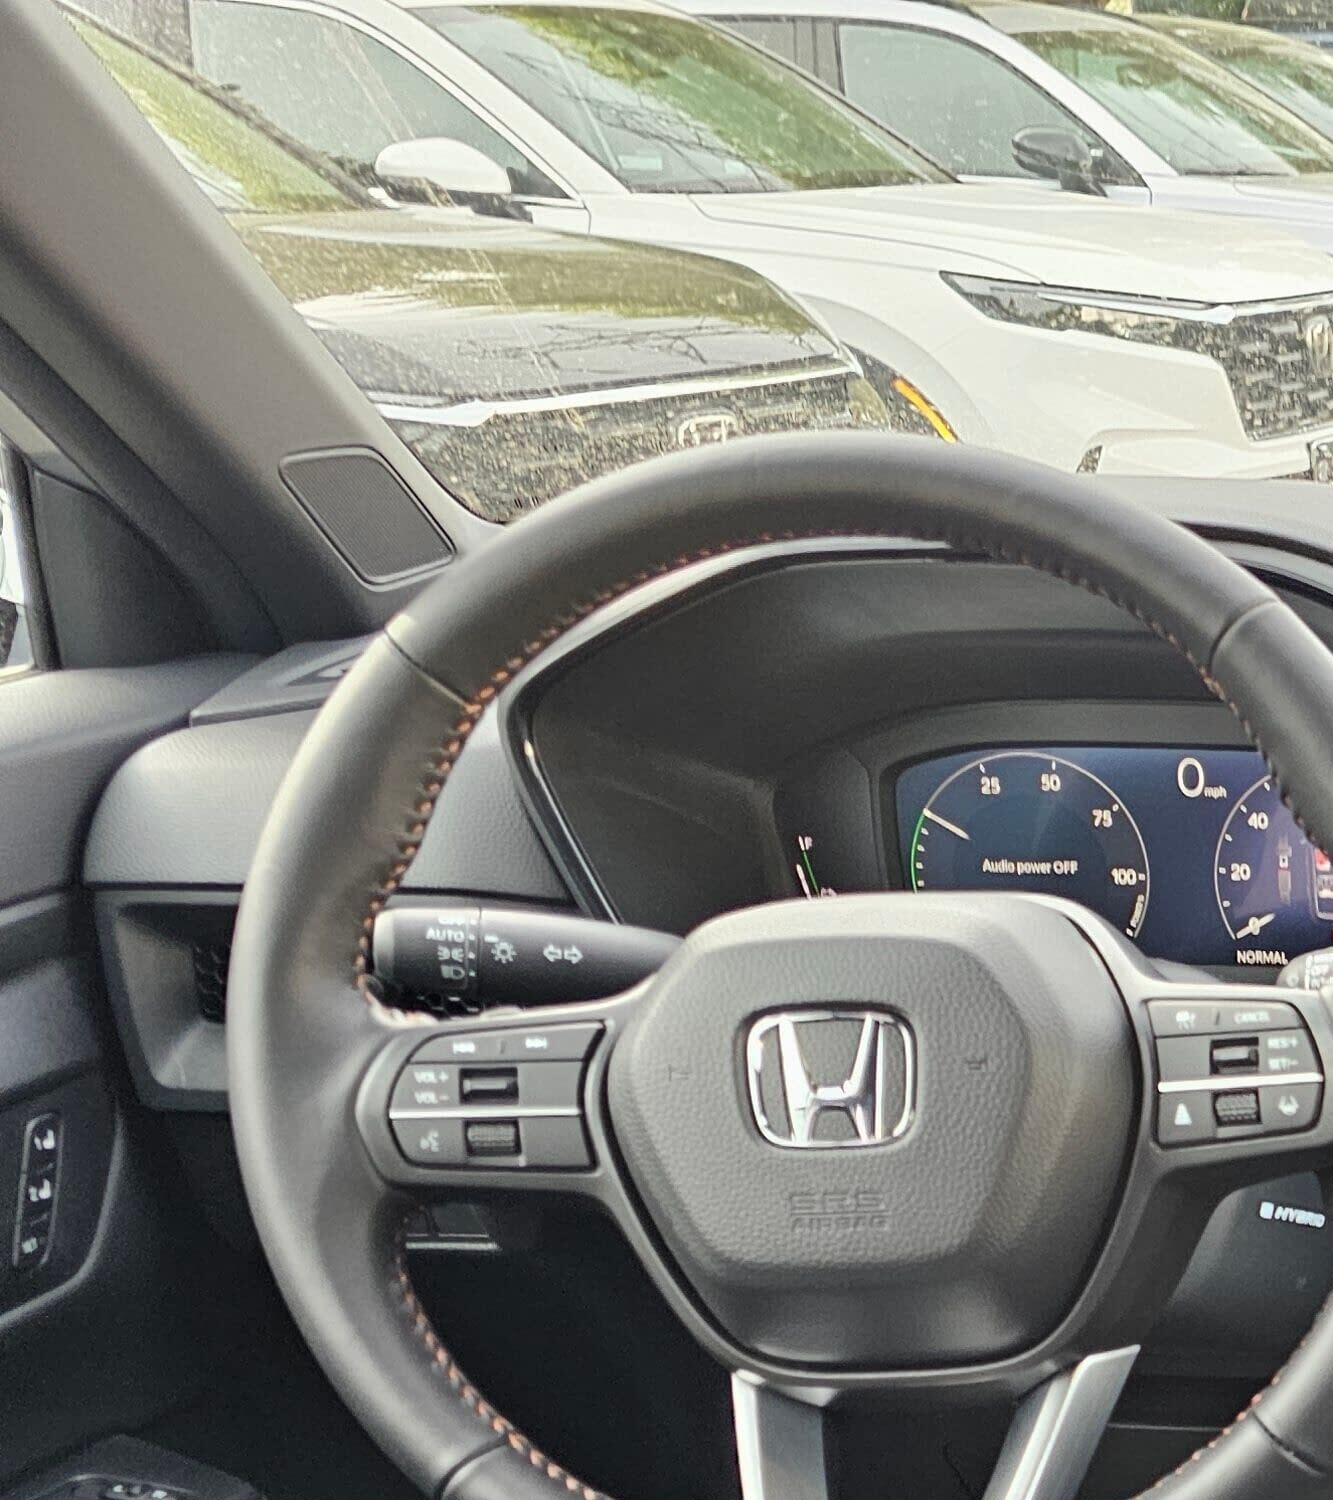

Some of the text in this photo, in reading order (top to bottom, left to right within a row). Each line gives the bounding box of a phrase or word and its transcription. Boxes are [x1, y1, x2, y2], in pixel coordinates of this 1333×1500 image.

[980, 775, 1001, 796] 25
[1040, 773, 1061, 792] 50
[1177, 756, 1206, 799] 0
[1204, 785, 1228, 801] mph
[1092, 808, 1113, 828] 75
[1247, 811, 1269, 830] 40
[982, 858, 1079, 876] Audio power OFF
[1110, 867, 1137, 886] 100
[1230, 862, 1252, 882] 20
[425, 927, 466, 943] AUTO
[1236, 949, 1290, 967] NORMAL
